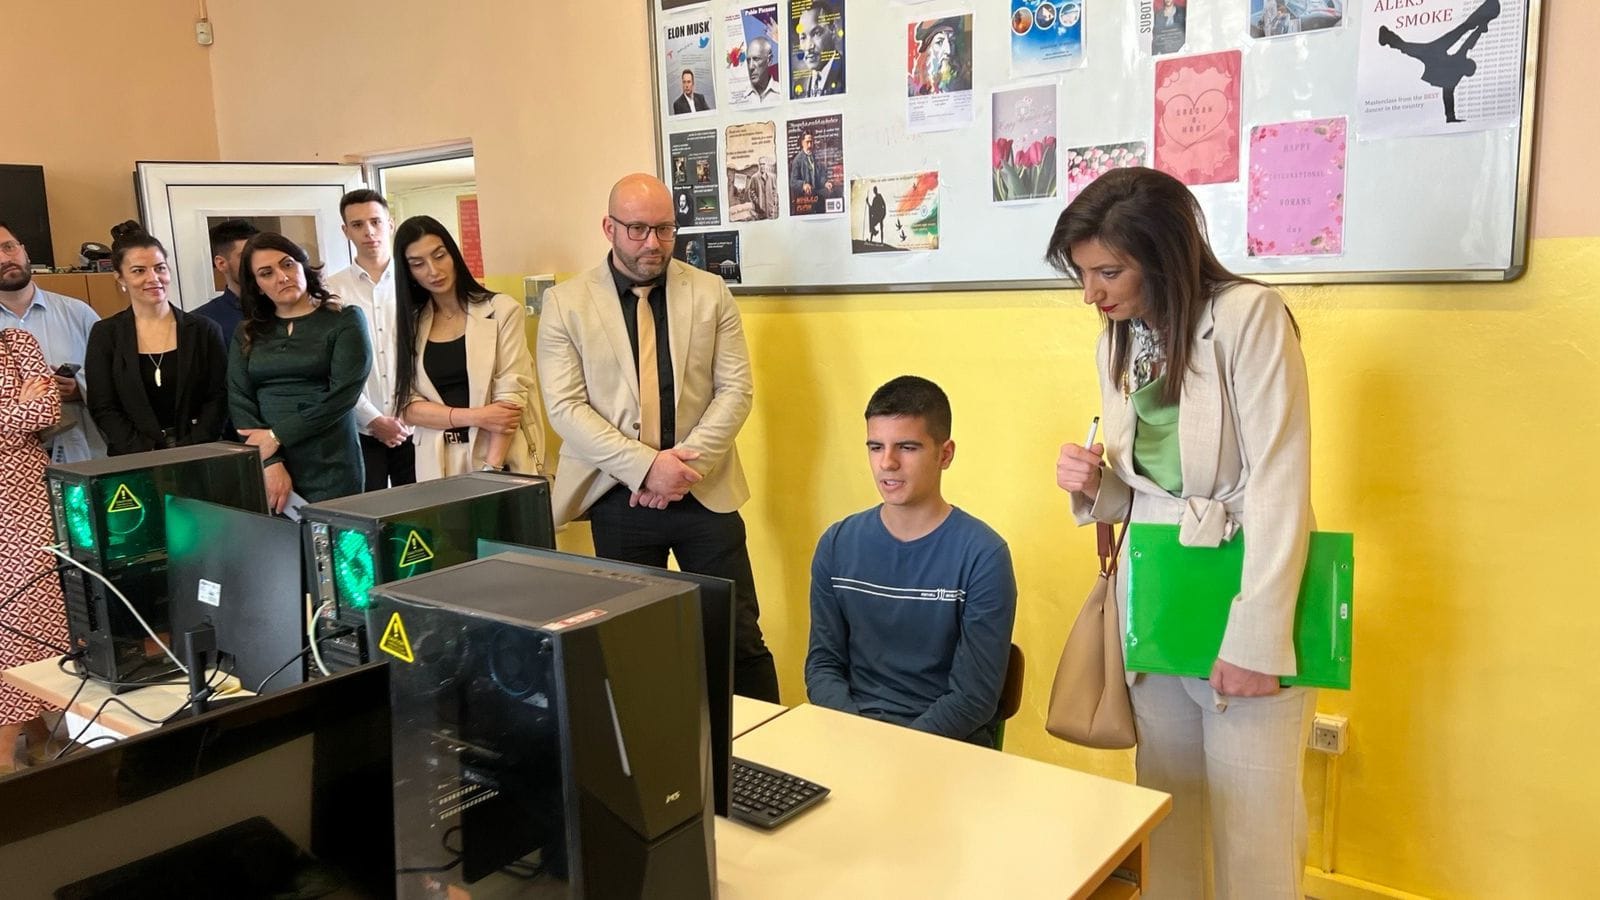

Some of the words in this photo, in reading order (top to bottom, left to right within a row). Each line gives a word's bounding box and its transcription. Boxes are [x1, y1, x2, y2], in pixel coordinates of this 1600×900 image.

[1395, 8, 1453, 29] SMOKE
[667, 25, 685, 40] ELON
[686, 20, 710, 36] MUSK
[1423, 92, 1439, 100] BEST
[1283, 143, 1311, 152] HAPPY
